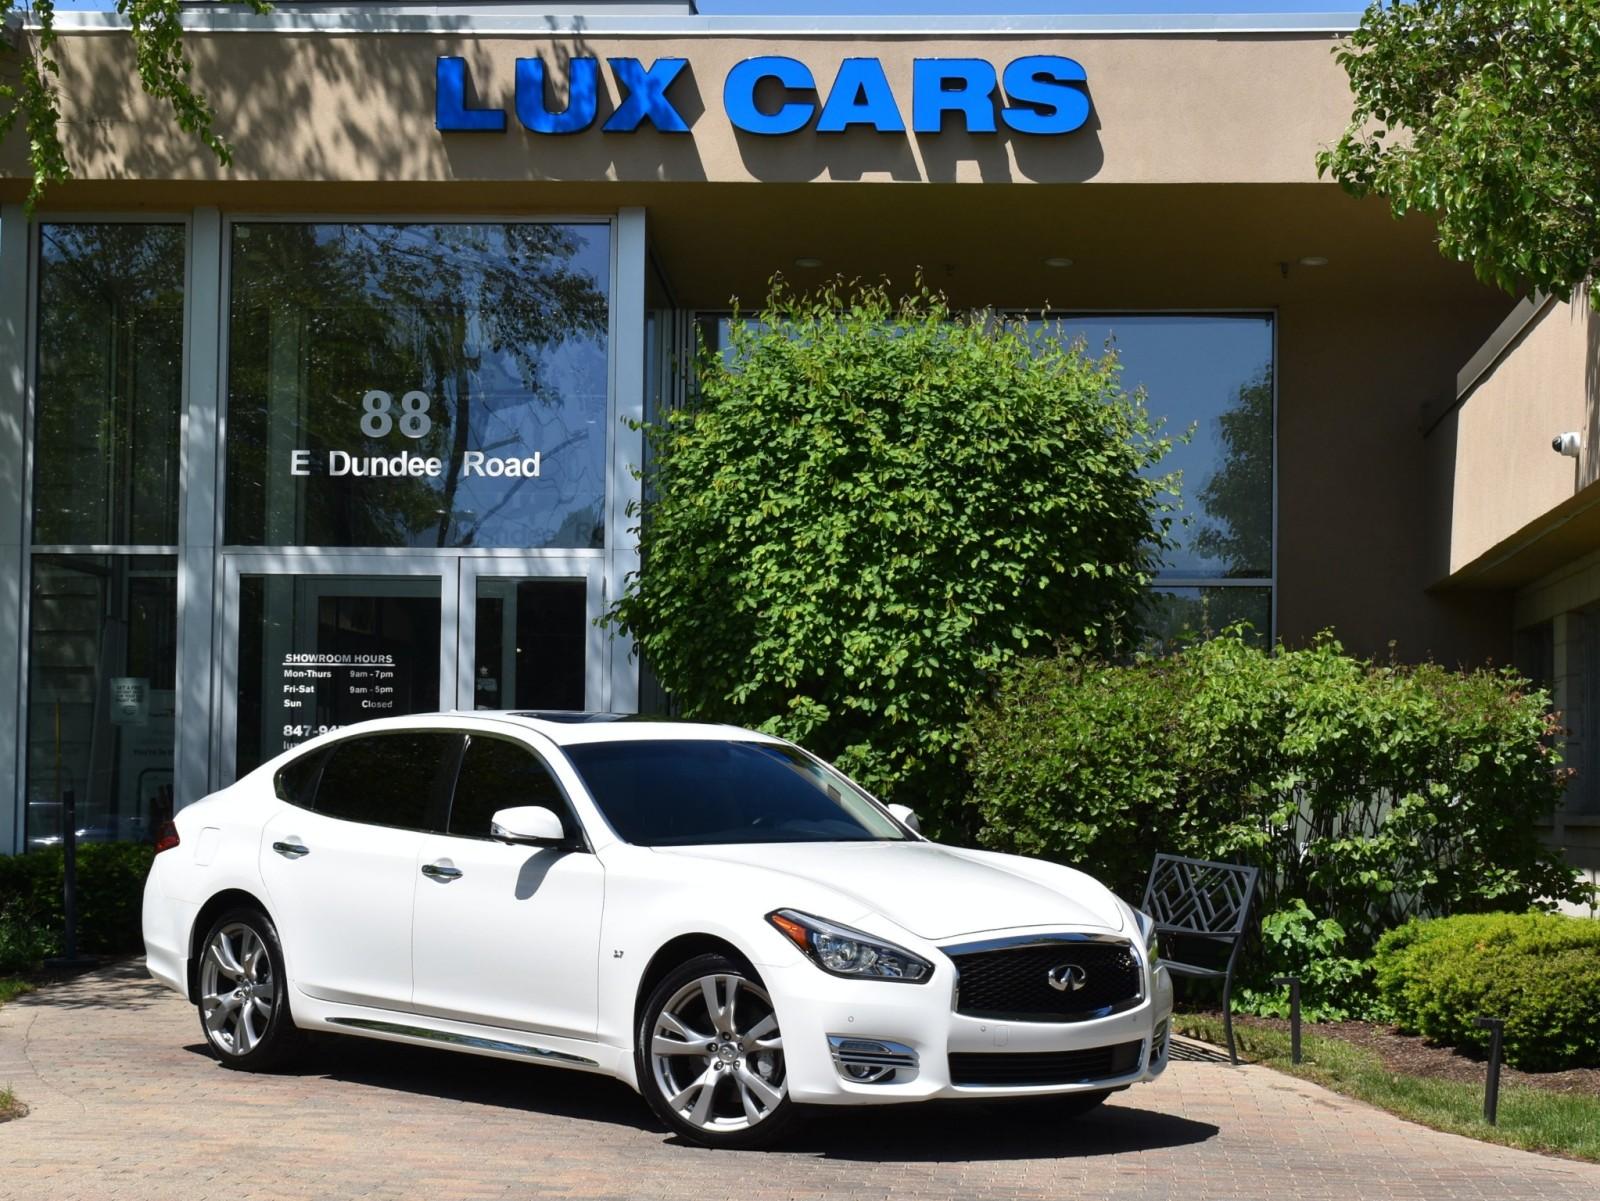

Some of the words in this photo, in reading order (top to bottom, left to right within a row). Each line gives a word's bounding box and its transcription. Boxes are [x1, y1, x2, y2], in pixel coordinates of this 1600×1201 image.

[434, 56, 691, 134] LUX
[723, 55, 1090, 135] CARS
[360, 389, 432, 438] 88
[290, 450, 311, 476] E
[329, 450, 442, 477] Dundee
[463, 451, 541, 477] Road
[285, 653, 351, 663] SHOWROOM
[354, 654, 393, 663] HOURS
[283, 669, 332, 678] Mon-Thurs
[349, 670, 368, 678] 9am
[375, 670, 394, 679] 7pm
[283, 685, 315, 693] Fri-Sat
[375, 686, 393, 694] 5pm
[283, 699, 302, 707] Sun
[361, 700, 393, 708] Closed
[283, 725, 346, 736] 847-94
